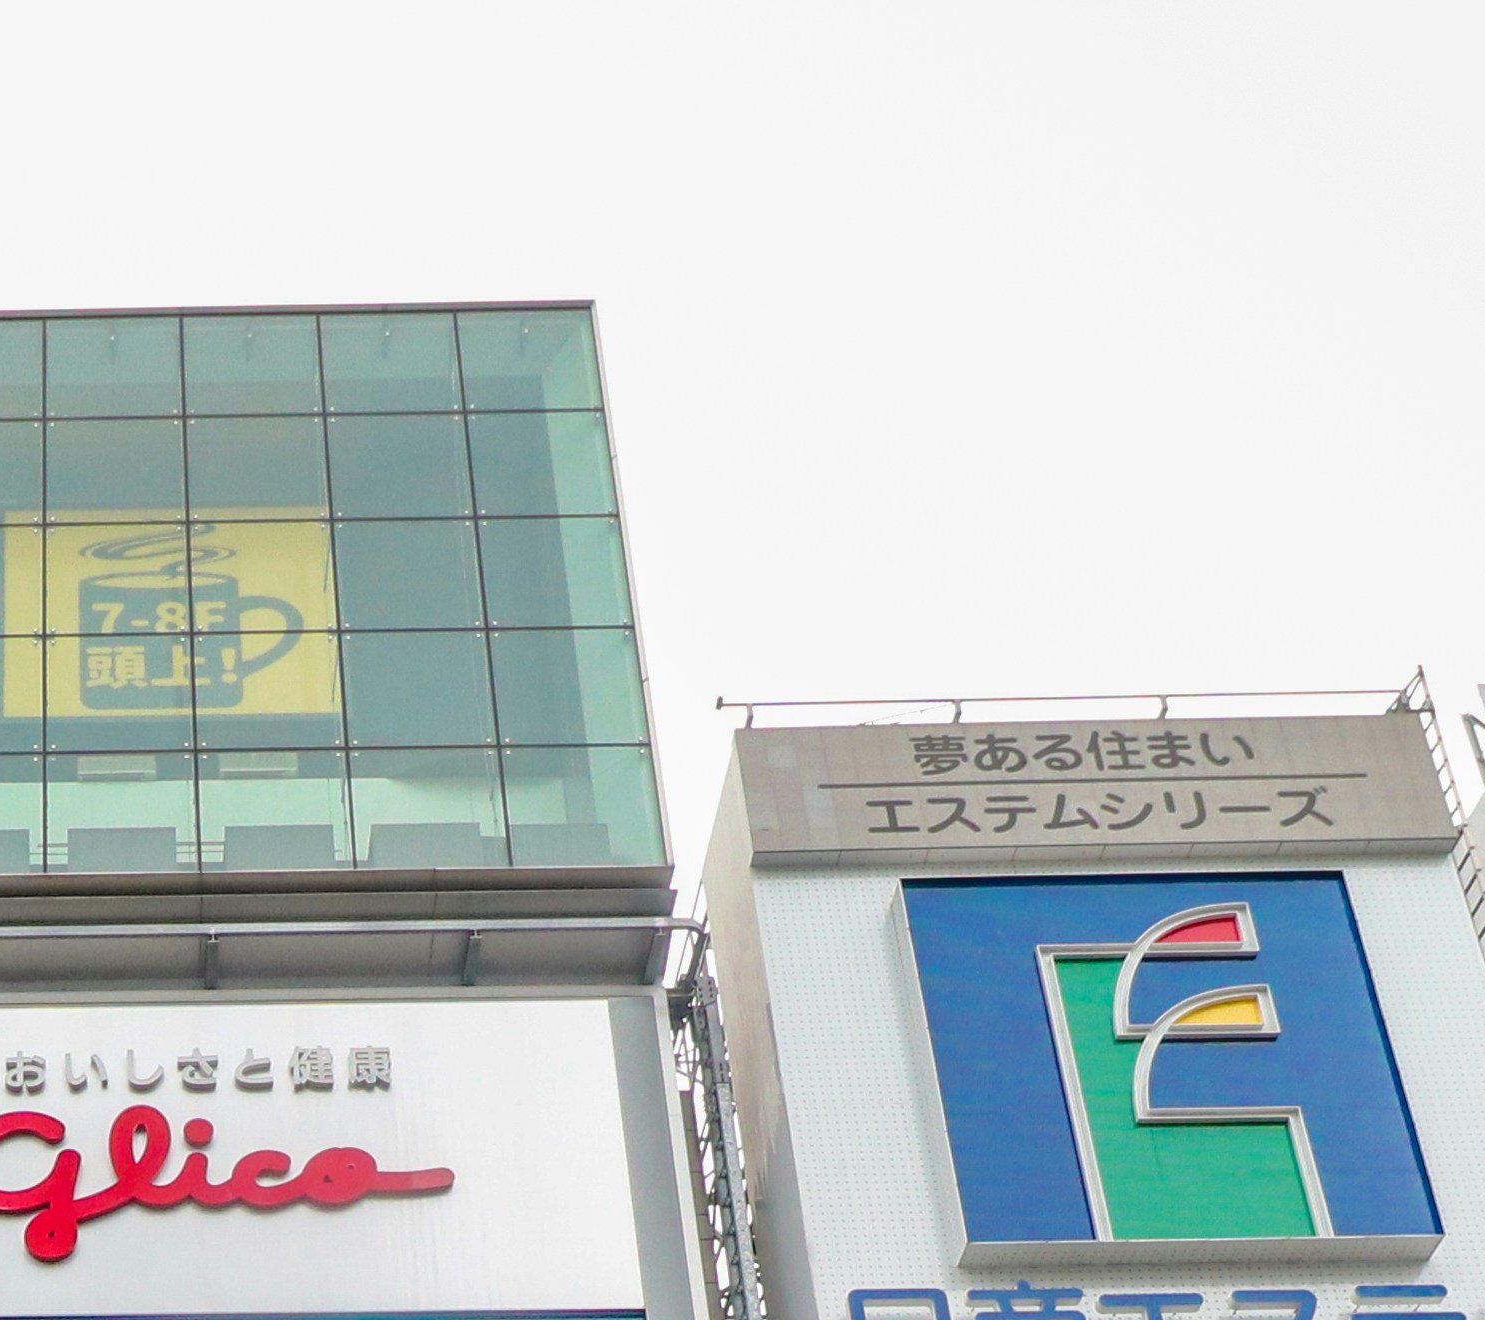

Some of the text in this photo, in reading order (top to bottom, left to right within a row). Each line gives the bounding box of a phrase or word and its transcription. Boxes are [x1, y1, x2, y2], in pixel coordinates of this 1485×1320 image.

[91, 600, 228, 634] 7-8F
[911, 730, 1255, 777] 夢ある住まい
[866, 786, 1336, 836] エステムシリーズ
[4, 1044, 393, 1093] おいしさと健康
